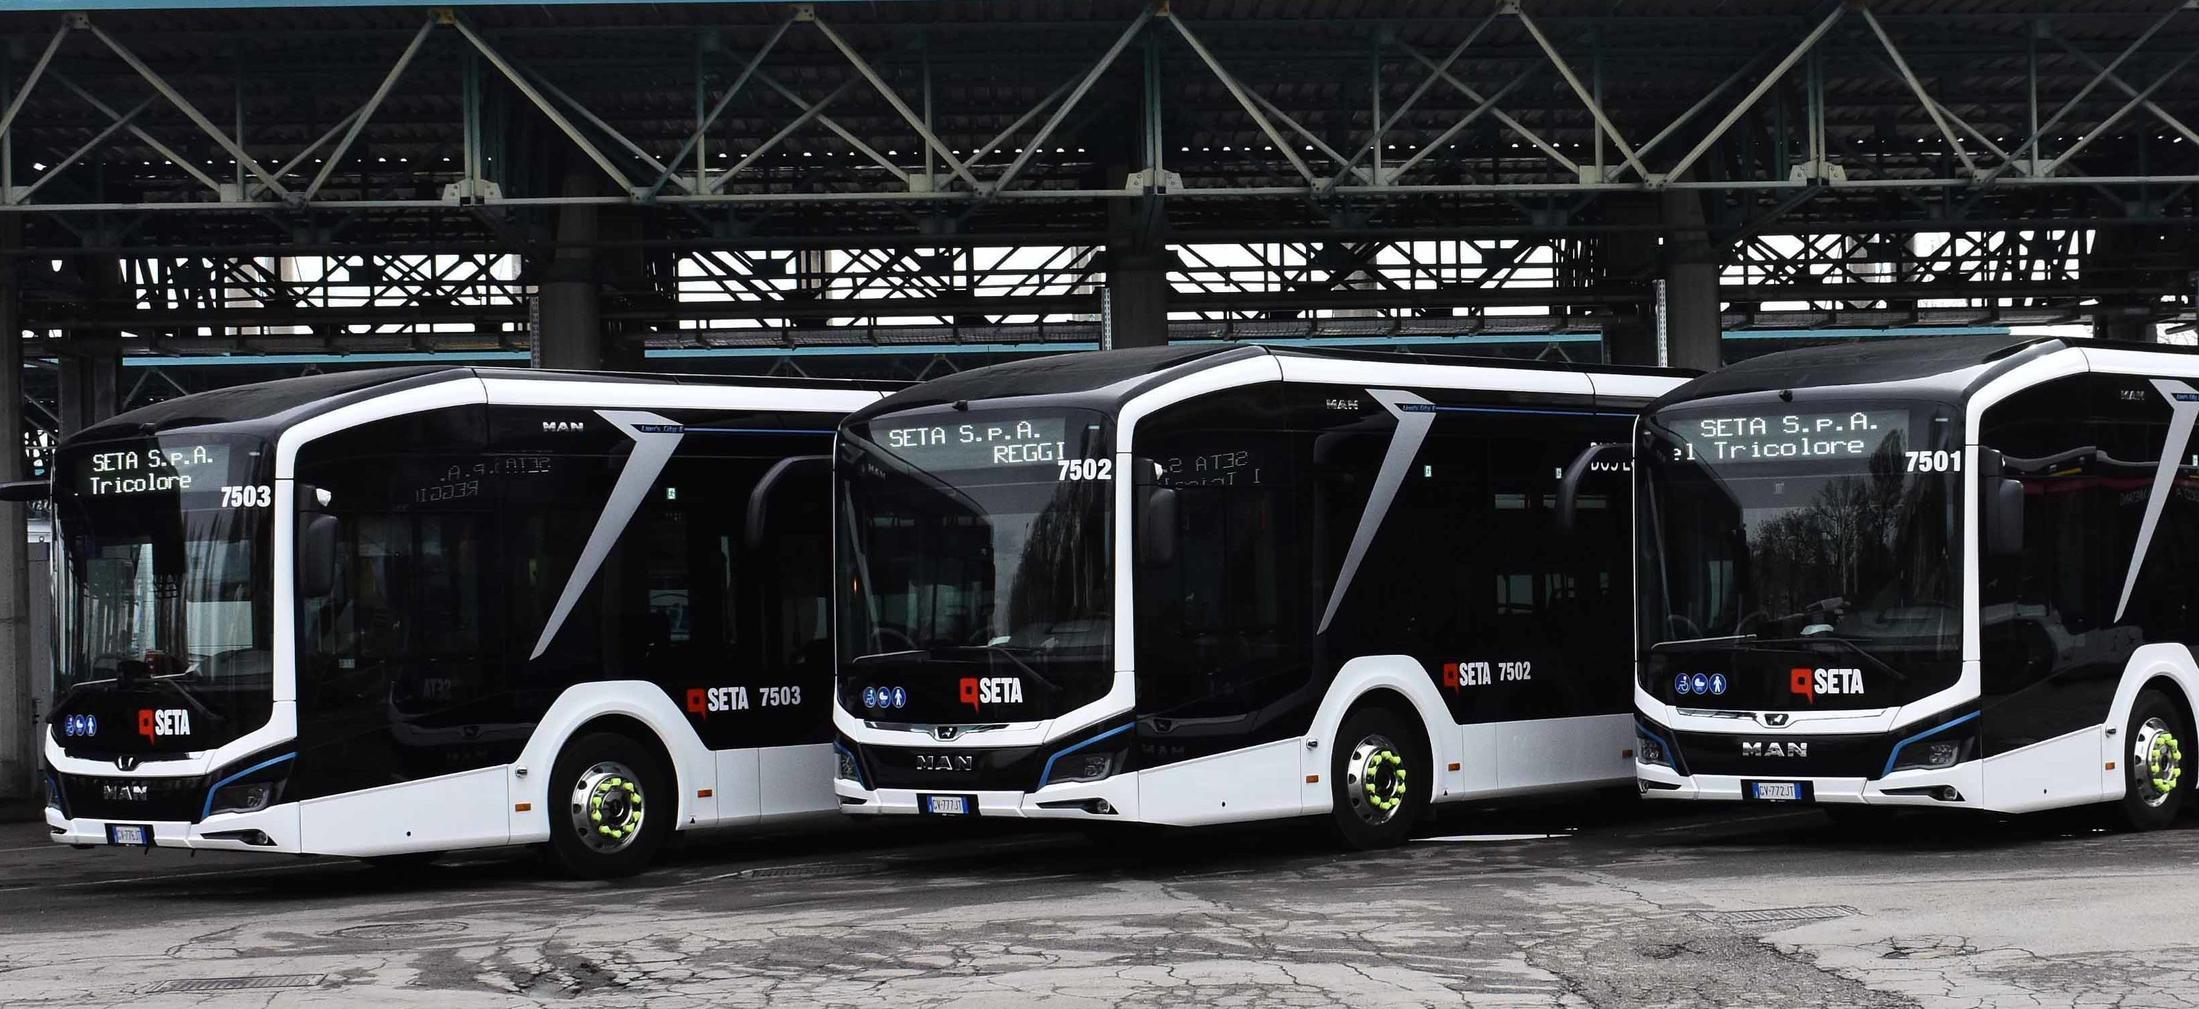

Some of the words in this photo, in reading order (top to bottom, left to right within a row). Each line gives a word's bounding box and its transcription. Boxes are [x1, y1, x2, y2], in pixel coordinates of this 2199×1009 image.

[542, 421, 584, 433] MAN
[889, 427, 946, 448] SETA
[1700, 417, 1767, 438] SETA
[993, 441, 1066, 464] REGGI
[1714, 437, 1865, 460] Tricolore
[92, 451, 138, 472] SETA
[1057, 458, 1113, 481] 7502
[1905, 450, 1961, 472] 7501
[90, 472, 192, 496] Tricolore
[220, 485, 271, 508] 7503
[1458, 661, 1492, 686] SETA
[1498, 661, 1532, 682] 7502
[1813, 668, 1865, 695] SETA
[707, 686, 749, 712] SETA
[759, 685, 801, 708] 7503
[979, 677, 1024, 704] SETA
[154, 708, 191, 736] SETA
[1742, 741, 1809, 758] MAN
[916, 755, 973, 772] MAN
[103, 785, 148, 800] MAN
